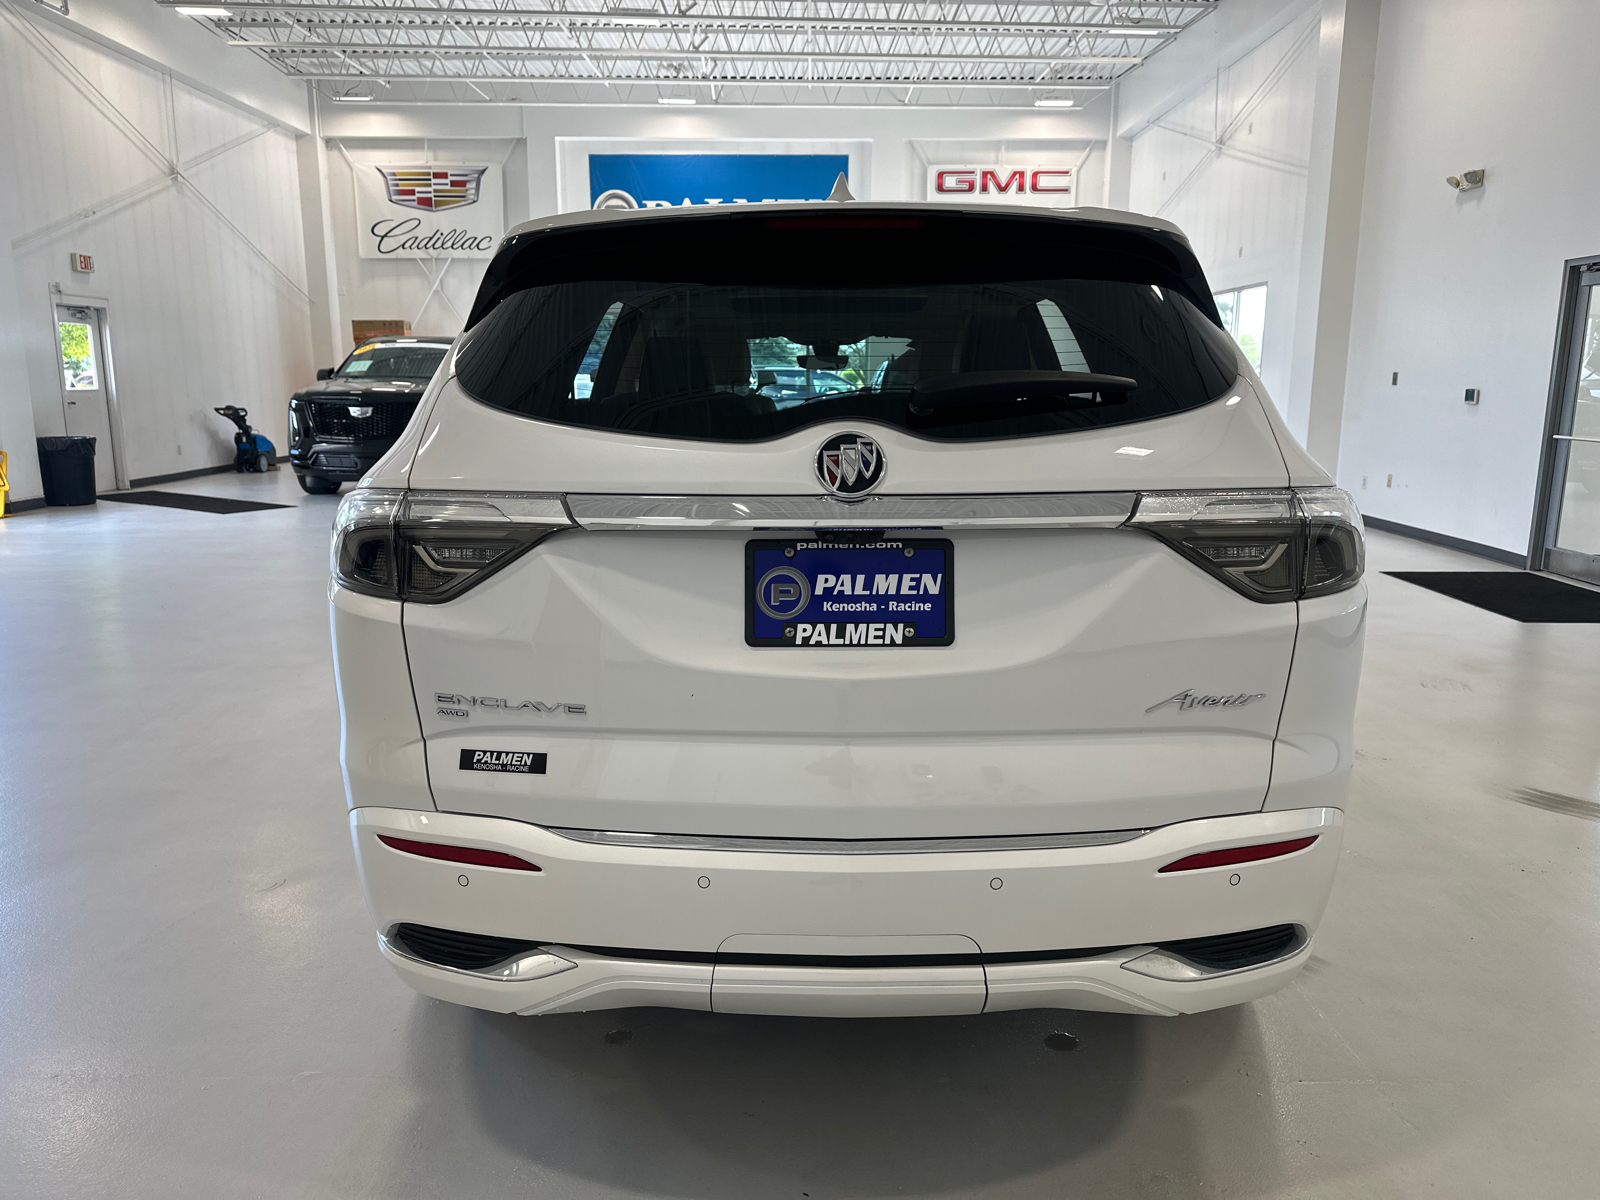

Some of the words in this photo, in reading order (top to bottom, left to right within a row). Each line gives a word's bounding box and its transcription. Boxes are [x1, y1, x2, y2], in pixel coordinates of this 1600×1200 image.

[935, 168, 1071, 194] GMC
[371, 218, 492, 254] Cadillac
[79, 254, 92, 270] EXIT
[797, 541, 903, 551] palmen.com
[770, 583, 800, 606] P
[814, 573, 943, 595] PALMEN
[823, 601, 877, 612] Kenosha
[888, 601, 932, 612] Racine
[795, 623, 904, 645] PALMEN
[434, 692, 587, 715] ENCLAVE
[1145, 688, 1267, 713] Avenir
[437, 708, 469, 718] AWD
[473, 751, 533, 766] PALMEN
[473, 763, 502, 771] KENOSHA
